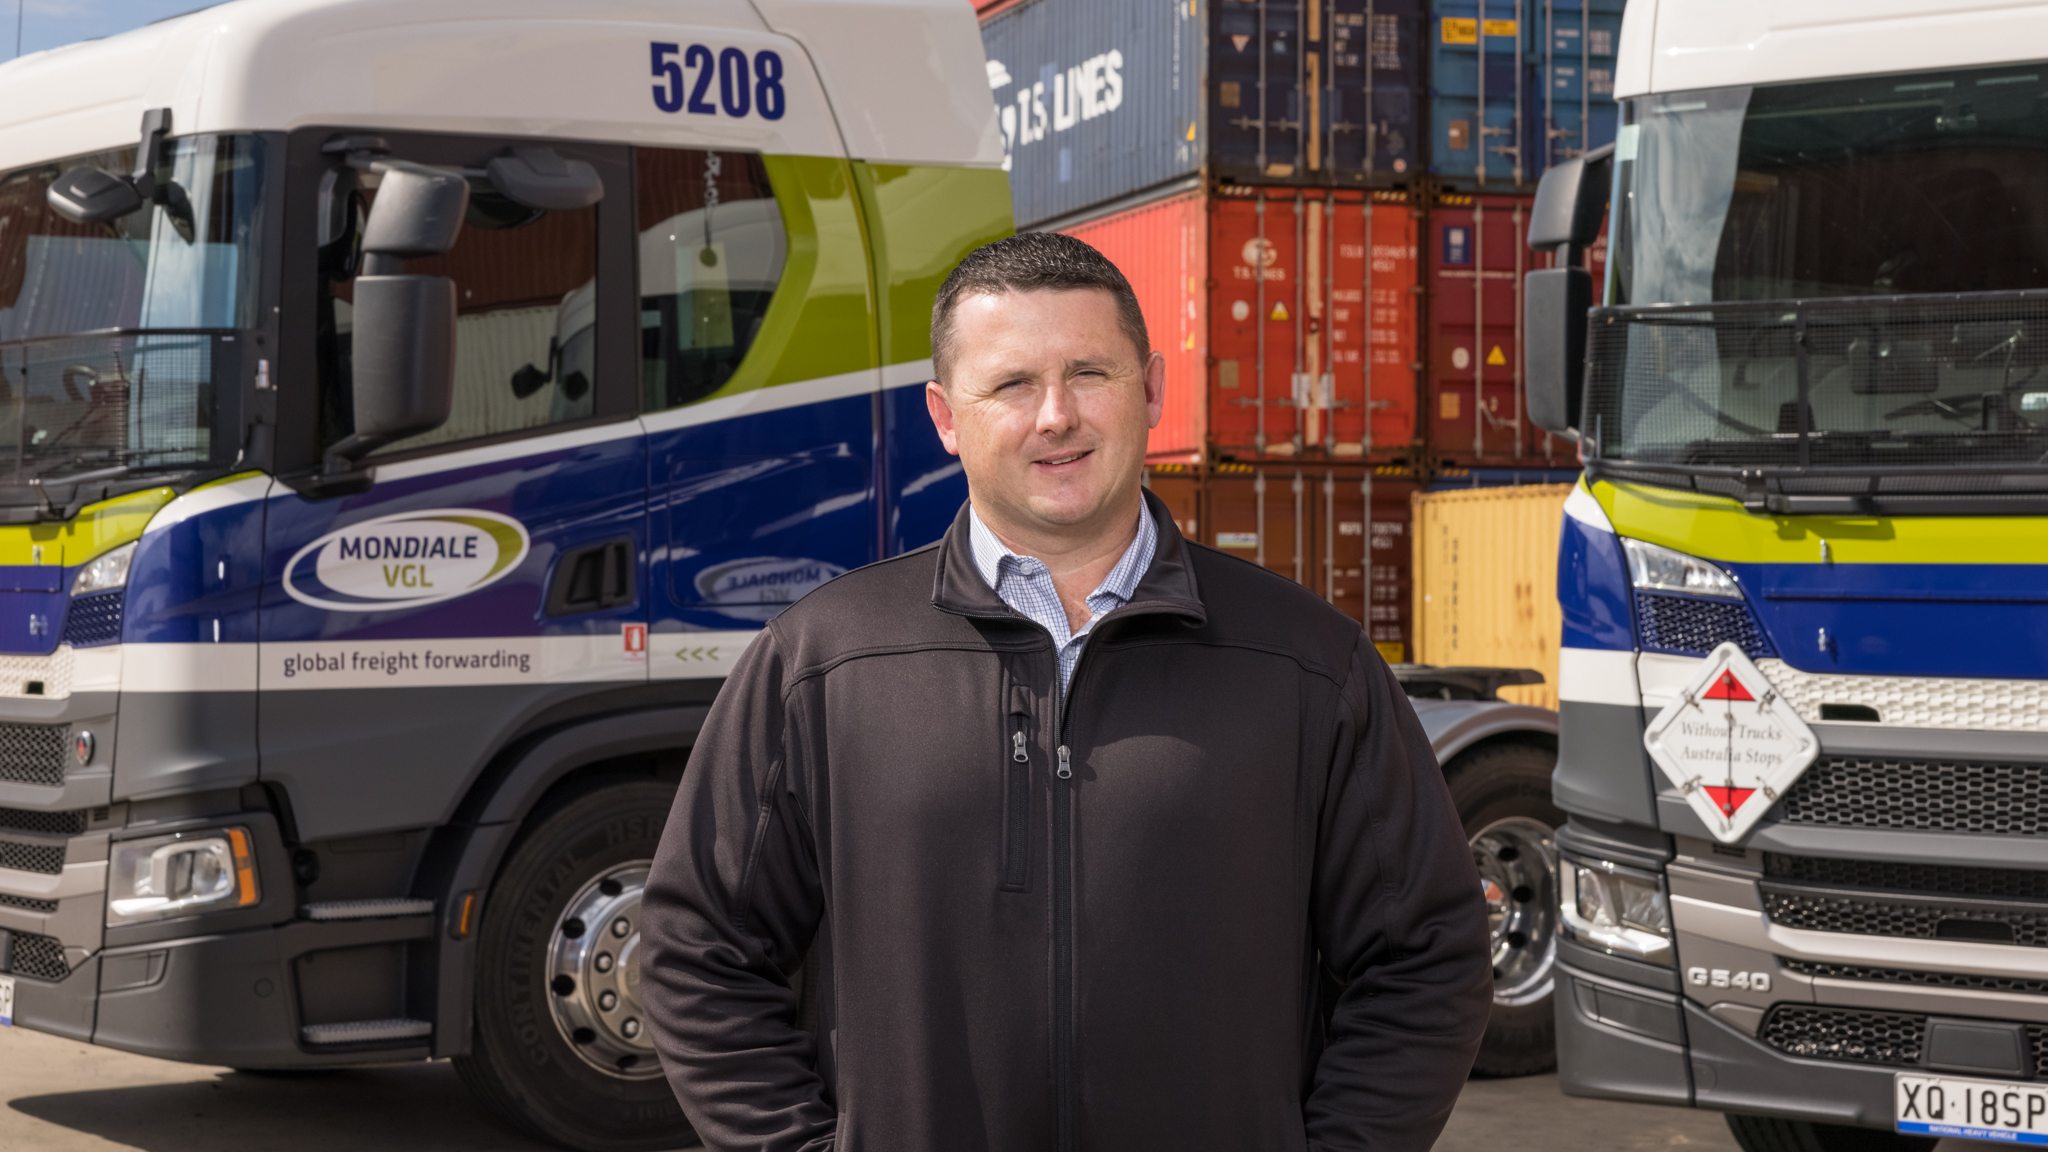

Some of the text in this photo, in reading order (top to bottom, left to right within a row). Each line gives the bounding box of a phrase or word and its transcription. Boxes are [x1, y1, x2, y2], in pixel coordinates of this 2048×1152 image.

[650, 41, 785, 120] 5208
[1054, 49, 1123, 132] LINES
[1252, 267, 1286, 282] LNES
[340, 536, 478, 559] MONDIALE
[383, 565, 433, 587] VGL
[284, 650, 531, 677] global freight forwarding
[1681, 721, 1782, 740] Withou Trucks
[1680, 745, 1782, 769] Australa Stops
[510, 850, 588, 1067] CONTINENTAL
[1928, 1124, 2018, 1140] NATIONAL HEAVY VEHICLE
